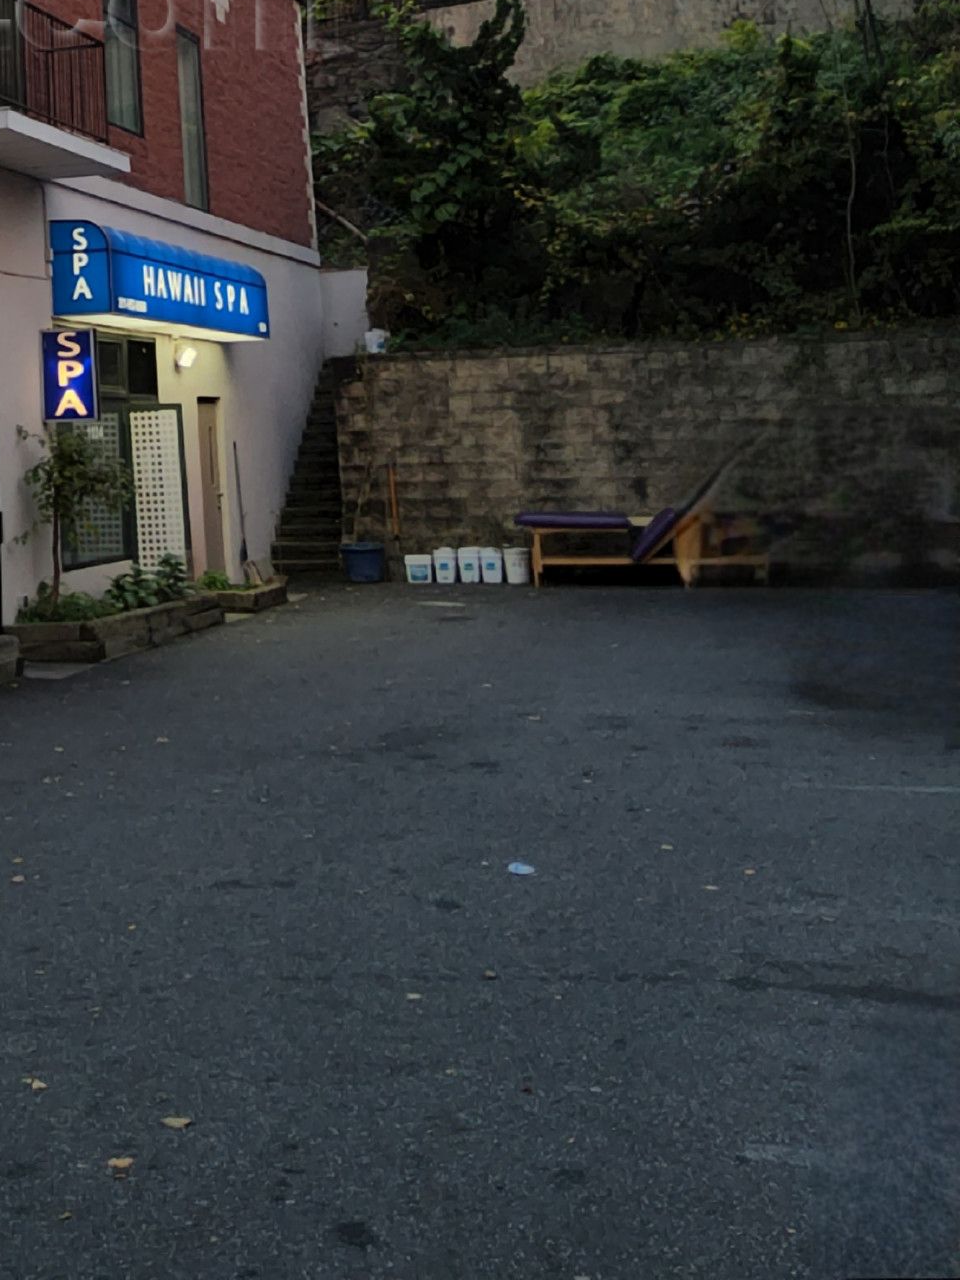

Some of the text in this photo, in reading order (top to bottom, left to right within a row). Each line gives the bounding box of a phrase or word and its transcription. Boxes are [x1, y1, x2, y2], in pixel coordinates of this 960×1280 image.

[72, 227, 93, 300] SPA
[143, 265, 249, 315] HAWAII SPA
[55, 332, 88, 417] SPA
